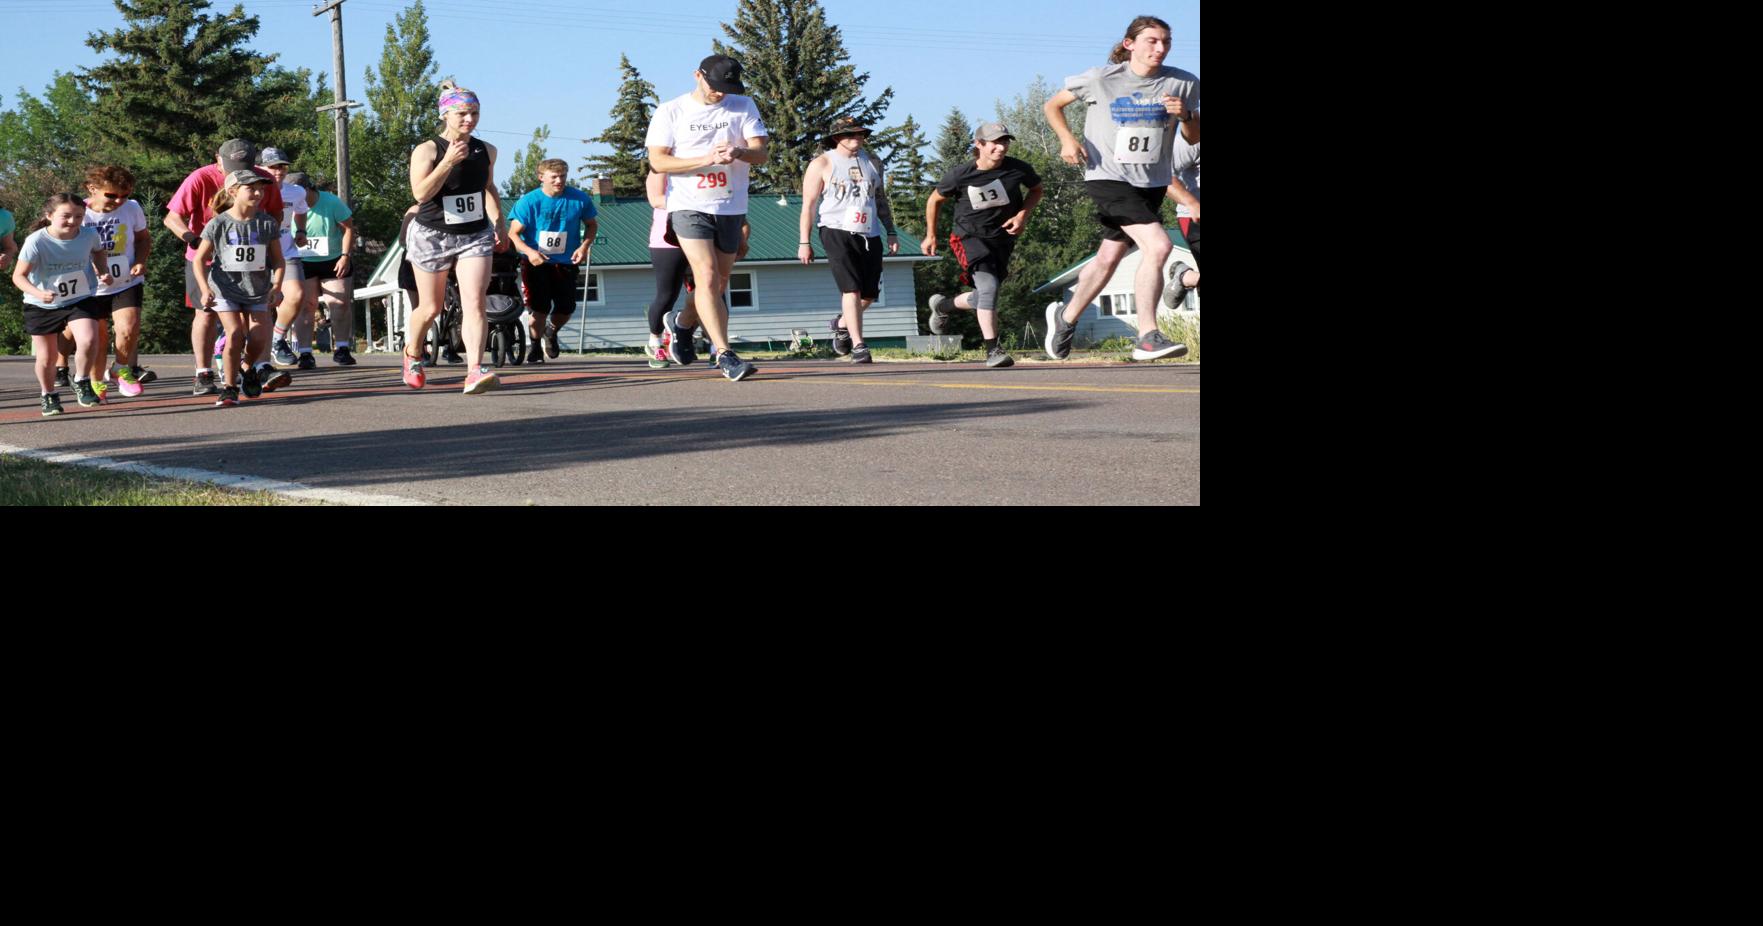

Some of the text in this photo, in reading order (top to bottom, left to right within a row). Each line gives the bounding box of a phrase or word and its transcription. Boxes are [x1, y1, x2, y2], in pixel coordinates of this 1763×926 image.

[690, 121, 729, 131] EYES UP
[1128, 136, 1150, 152] 81
[696, 171, 727, 189] 299
[978, 189, 998, 202] 13
[455, 196, 475, 213] 96
[853, 211, 867, 224] 36
[546, 237, 561, 248] 88
[235, 247, 255, 262] 98
[111, 263, 121, 278] 0
[58, 279, 78, 297] 97
